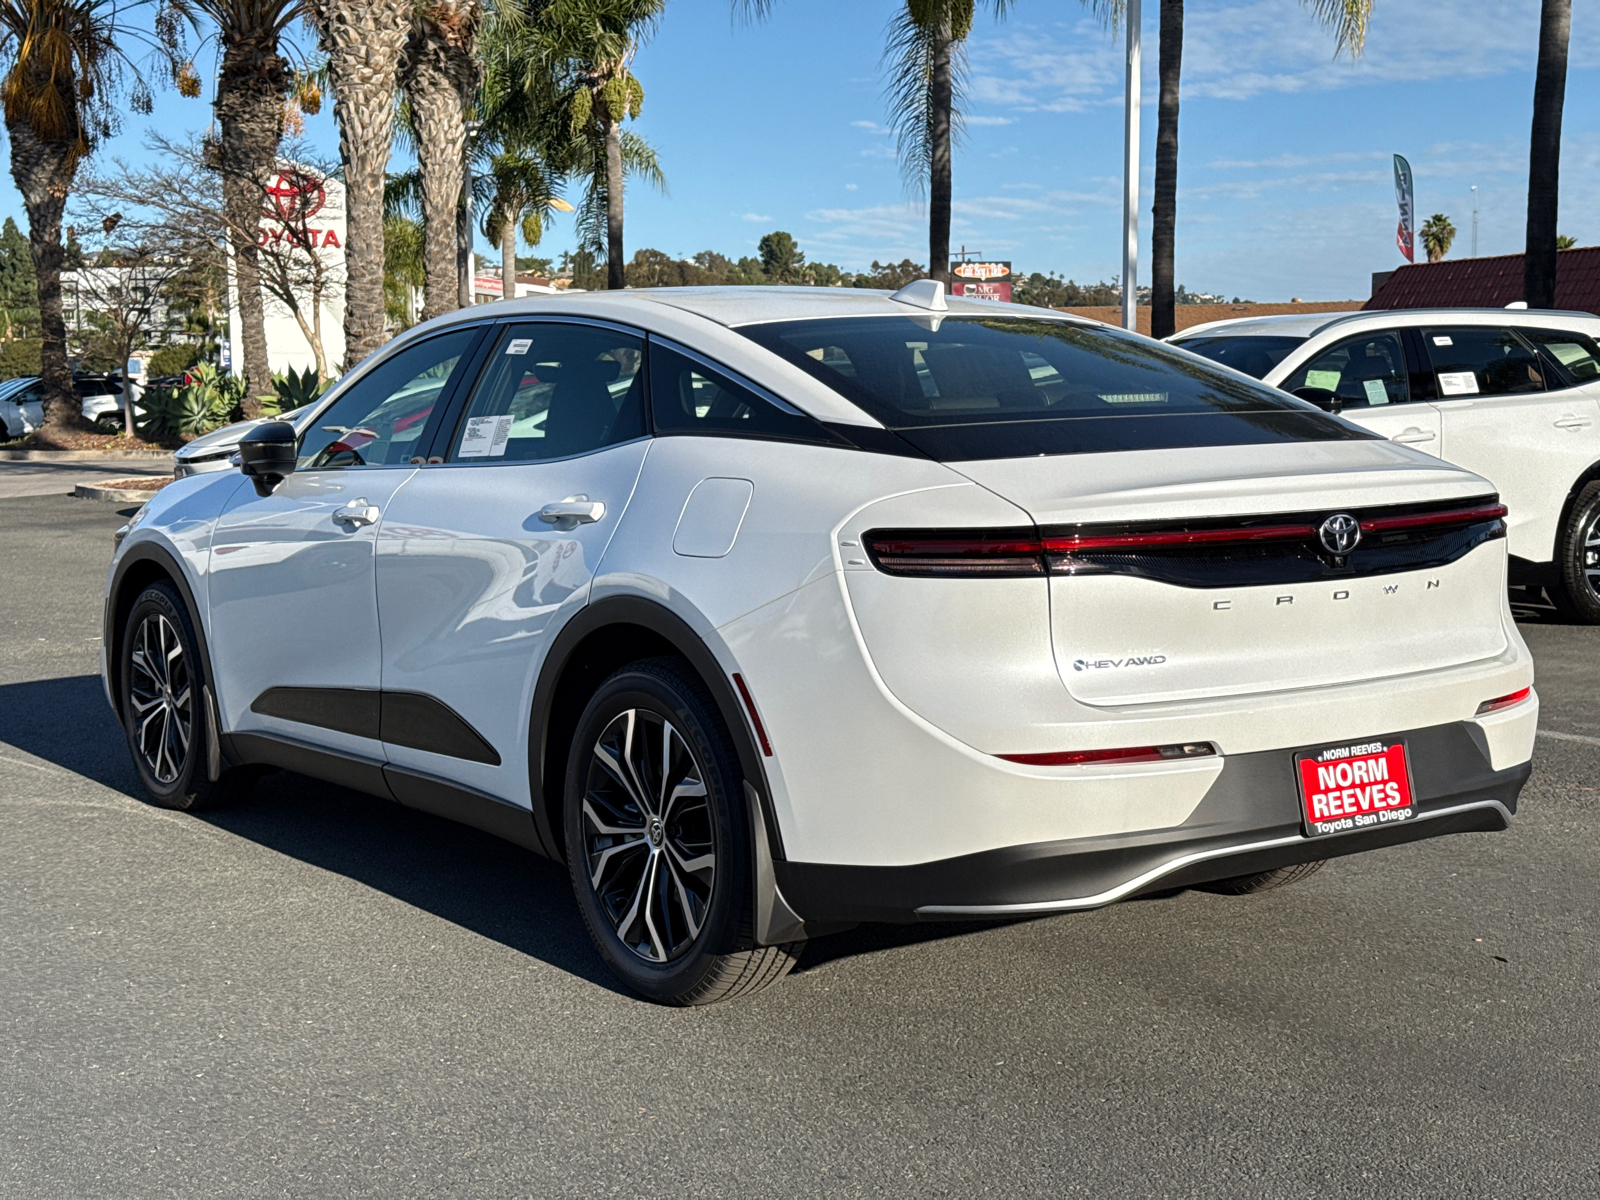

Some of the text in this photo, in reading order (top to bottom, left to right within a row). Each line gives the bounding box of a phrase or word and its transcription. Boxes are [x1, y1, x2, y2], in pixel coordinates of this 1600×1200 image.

[258, 227, 341, 248] OYOTA
[1212, 579, 1440, 610] CROWN
[1124, 655, 1166, 667] AWD
[1323, 742, 1382, 761] NORM REEVES
[1317, 757, 1389, 790] NORM
[1312, 782, 1401, 818] REEVES
[1315, 808, 1412, 834] Toyota San Diego
